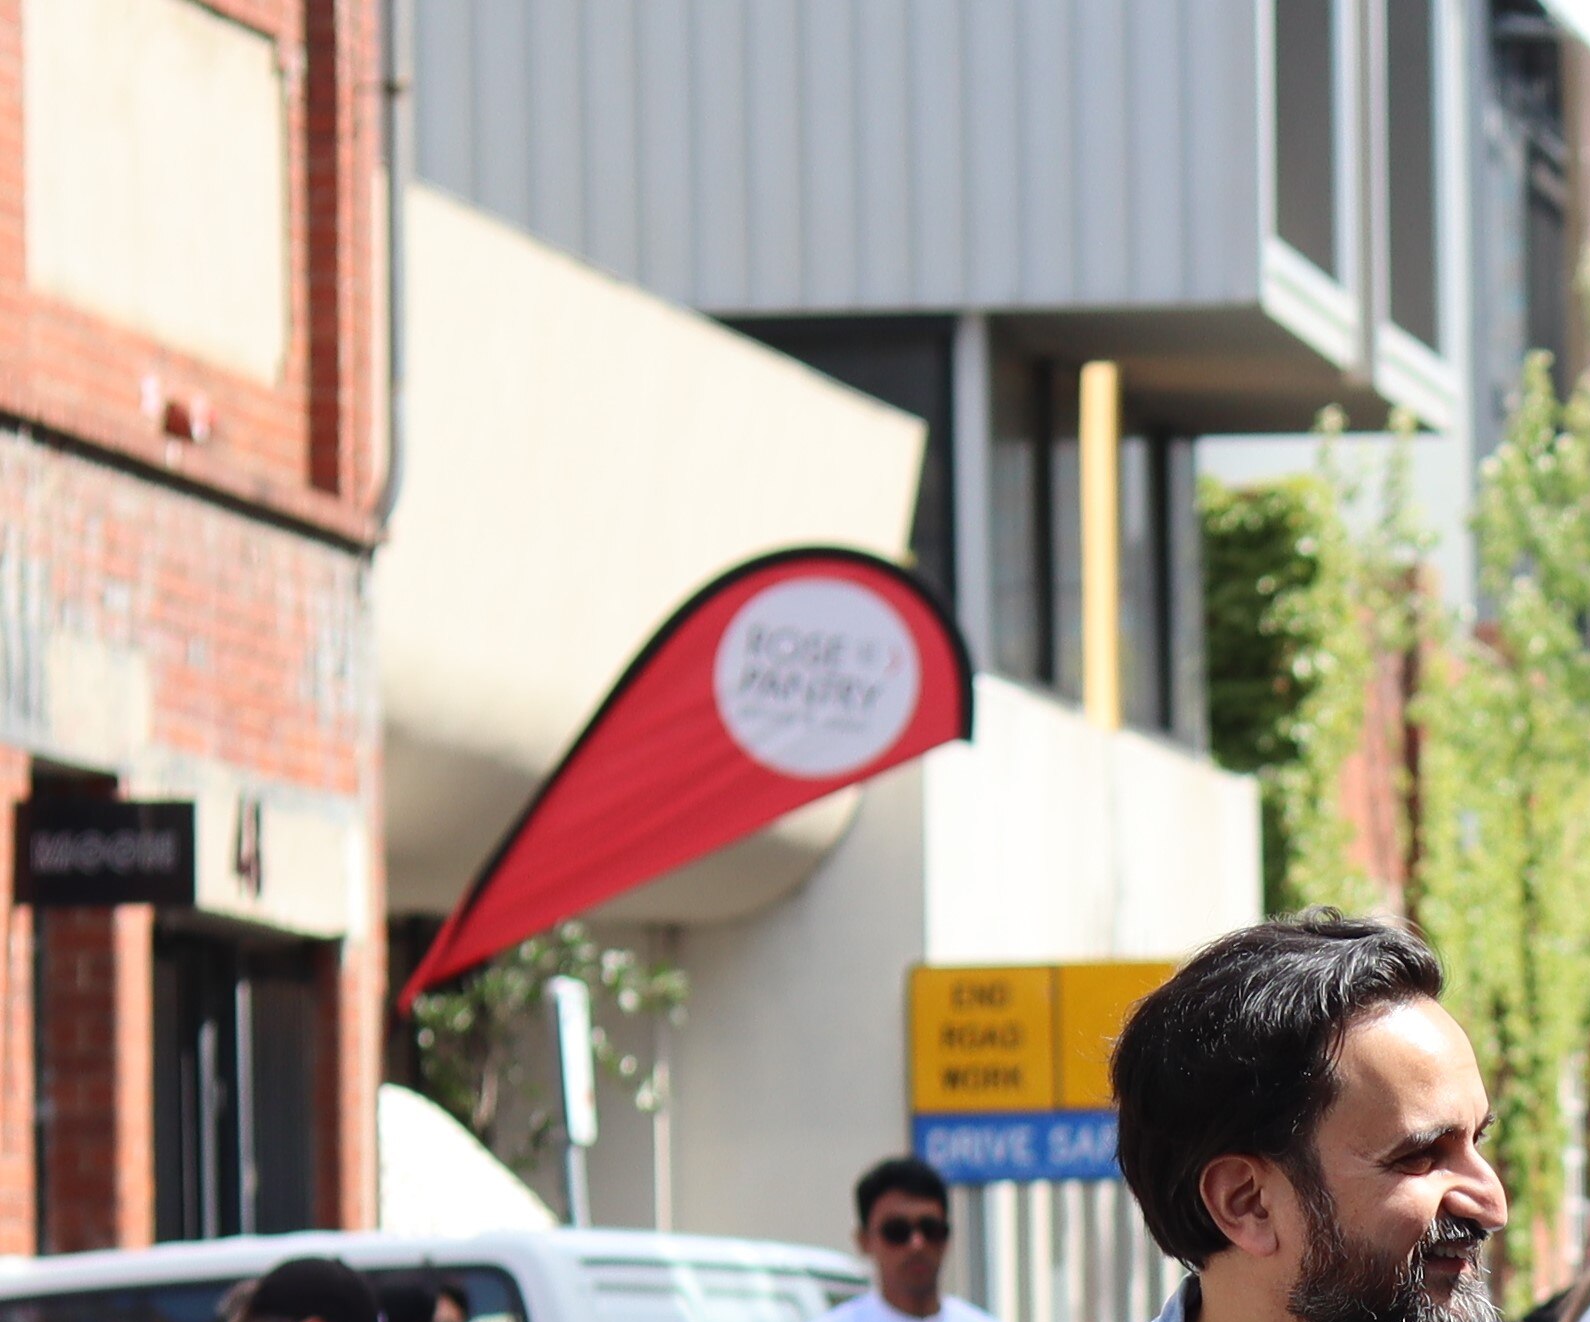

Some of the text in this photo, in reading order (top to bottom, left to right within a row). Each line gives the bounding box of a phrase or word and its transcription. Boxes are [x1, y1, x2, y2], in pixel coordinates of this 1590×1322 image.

[952, 978, 1010, 1011] END
[940, 1019, 1021, 1051] ROAD
[941, 1064, 1021, 1092] WORK
